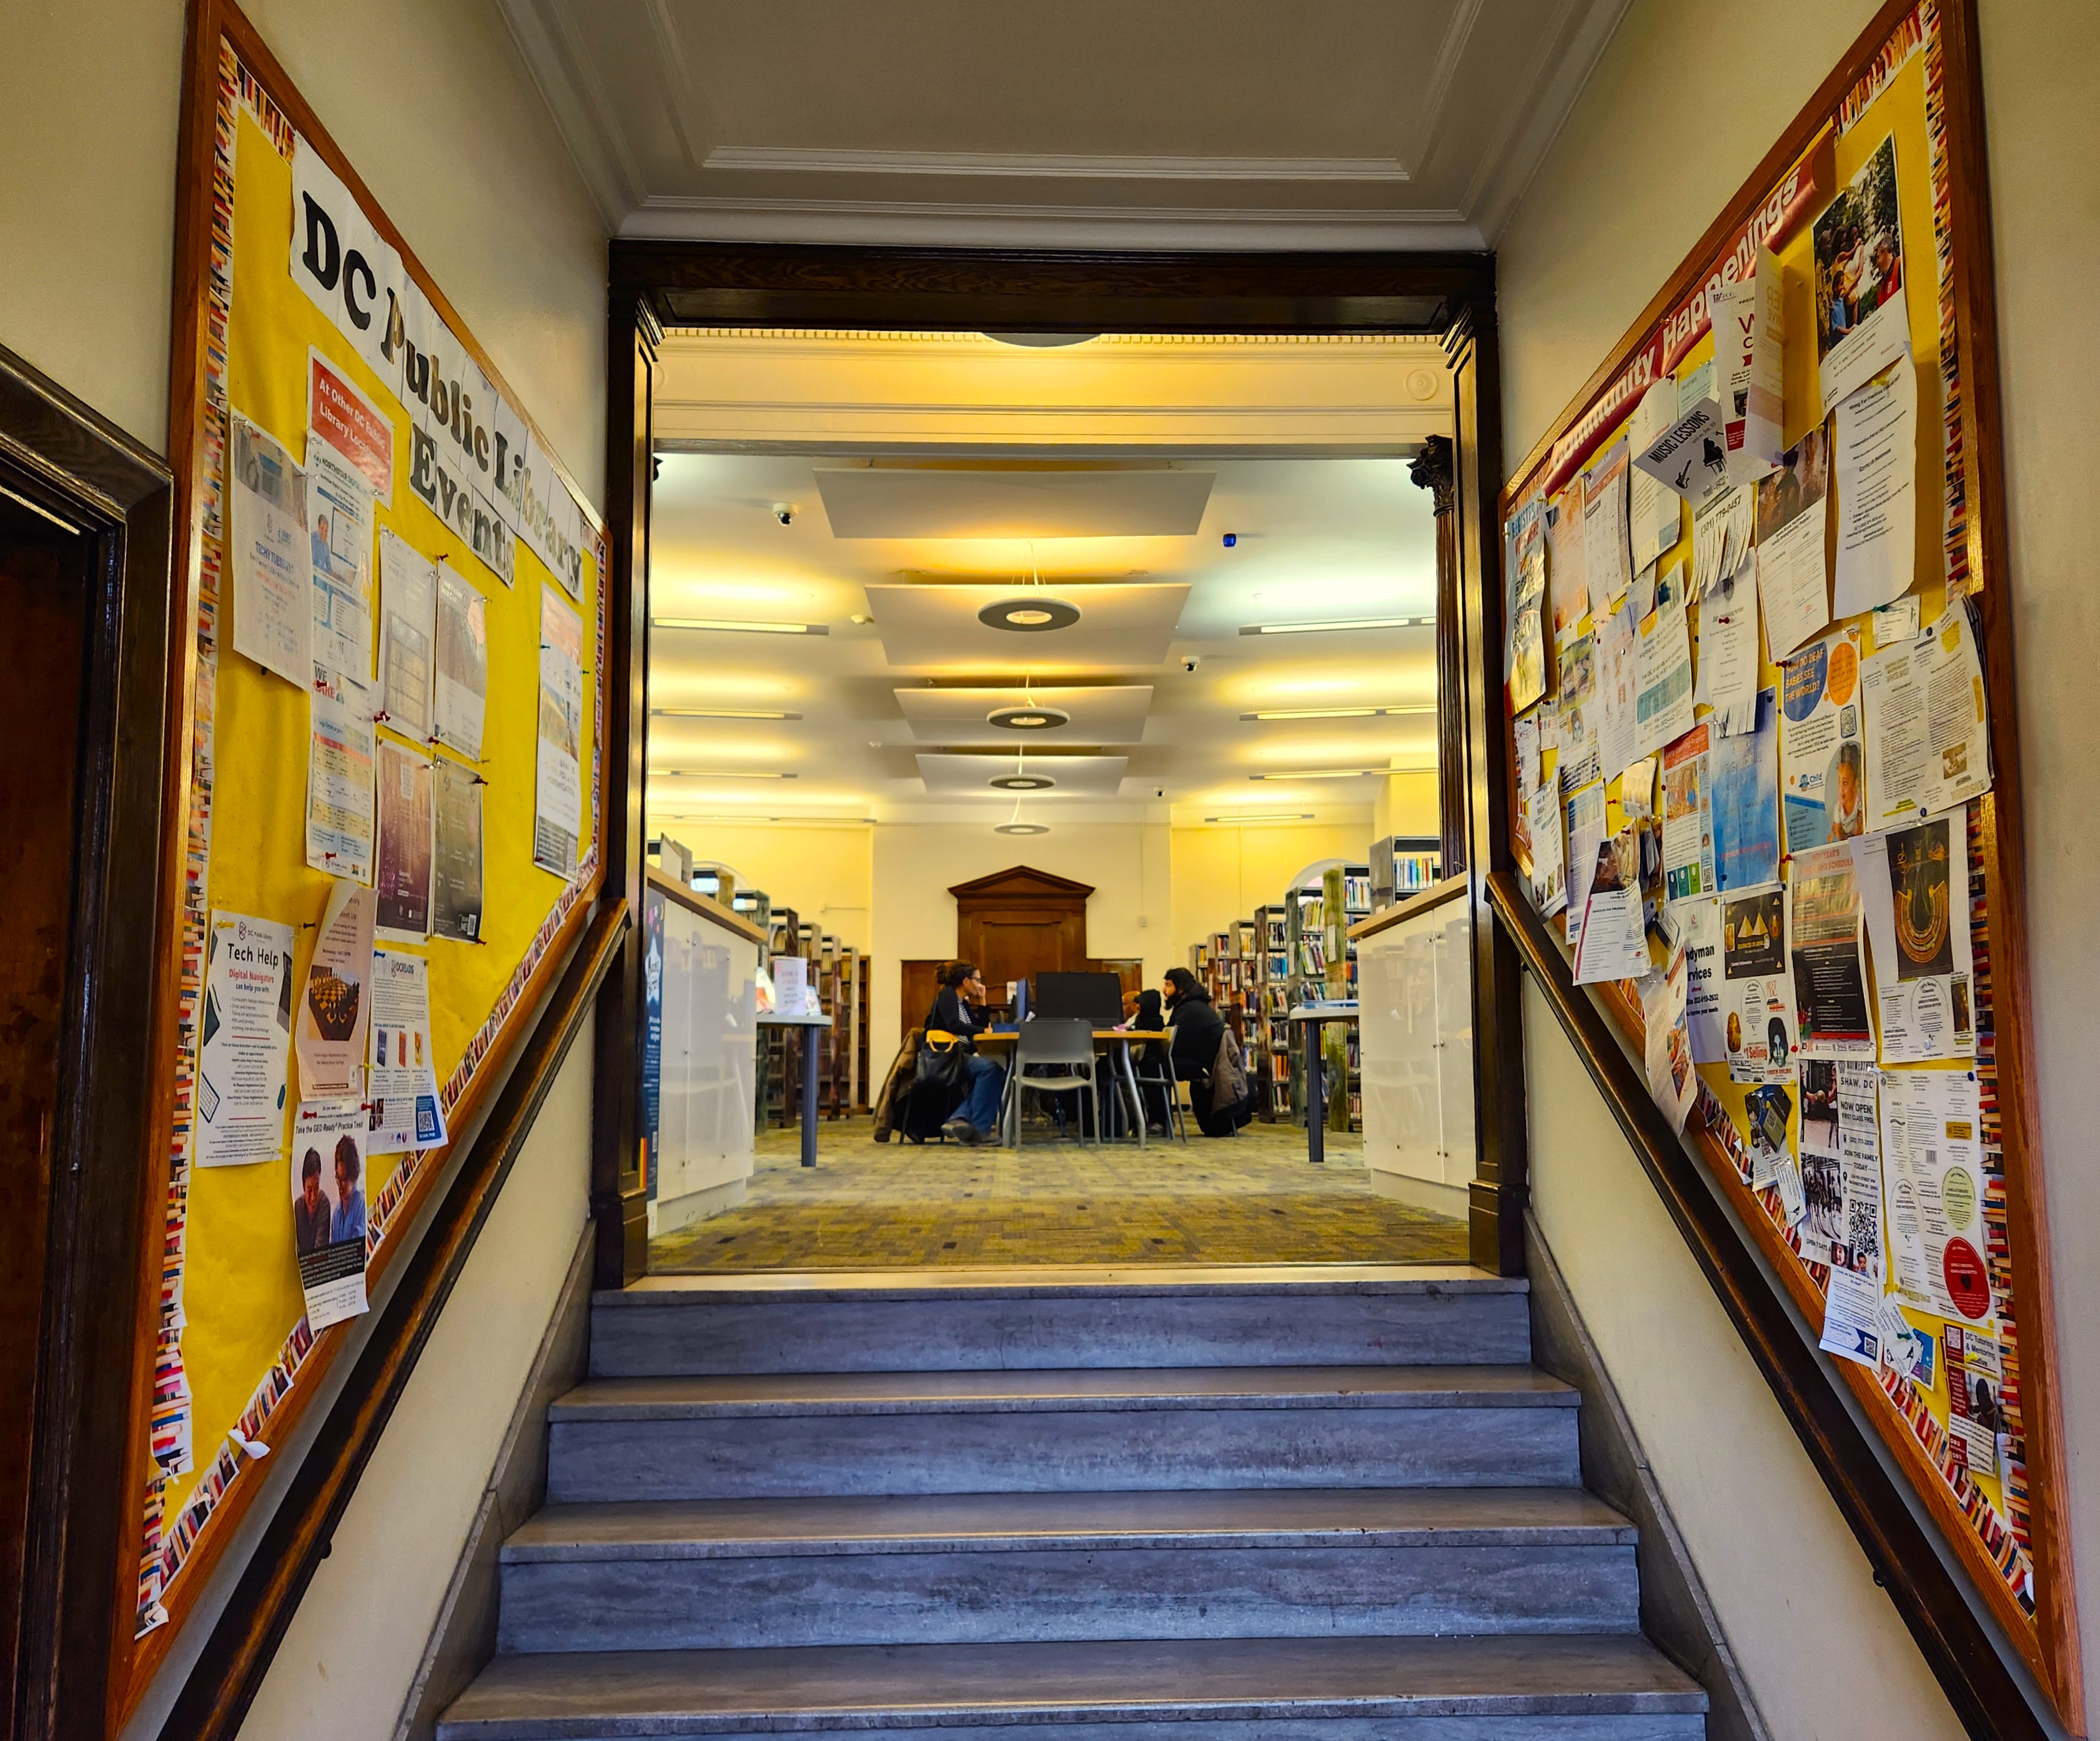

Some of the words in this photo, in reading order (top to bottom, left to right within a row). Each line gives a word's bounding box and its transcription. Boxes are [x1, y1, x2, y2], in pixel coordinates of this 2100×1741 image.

[1739, 297, 1755, 305] PROJE
[1552, 347, 1655, 473] Community
[1662, 166, 1801, 361] Happenings
[302, 190, 376, 330] DC
[380, 287, 489, 472] Public
[495, 431, 582, 593] Library
[319, 378, 329, 397] At
[331, 388, 354, 417] Other
[354, 410, 365, 427] DC
[320, 401, 349, 437] Library
[1648, 436, 1678, 464] MUSIC
[1673, 410, 1710, 445] LESSONS
[410, 422, 515, 584] Events
[1786, 659, 1800, 673] HOW
[1800, 655, 1808, 666] DO
[1808, 648, 1824, 663] DEAF
[315, 666, 327, 681] WE
[1786, 673, 1803, 689] BABIES
[1803, 668, 1815, 679] SEE
[1785, 691, 1795, 703] THE
[1795, 680, 1820, 698] WORLD?
[227, 943, 253, 962] Tech
[257, 947, 279, 970] Help
[1686, 945, 1715, 962] ndyman
[229, 969, 248, 980] Digital
[249, 972, 274, 984] Navigators
[1688, 967, 1712, 982] rvices
[1750, 1046, 1768, 1060] Selling
[1841, 1077, 1861, 1088] SHAW,
[1863, 1080, 1873, 1088] DC
[1841, 1101, 1855, 1112] NOW
[1855, 1103, 1873, 1115] OPEN!
[1852, 1114, 1863, 1122] CLASS
[296, 1126, 305, 1134] Take
[314, 1125, 322, 1133] GED
[338, 1122, 353, 1131] Practice
[354, 1121, 363, 1129] Test
[1861, 1153, 1878, 1162] FAMILY
[1853, 1162, 1868, 1171] TODAY
[1806, 1238, 1816, 1246] OPEN
[1818, 1241, 1828, 1251] DAYS
[1966, 1332, 1973, 1341] DC
[1974, 1335, 1993, 1349] Tutoring
[1971, 1344, 1996, 1361] Mentoring
